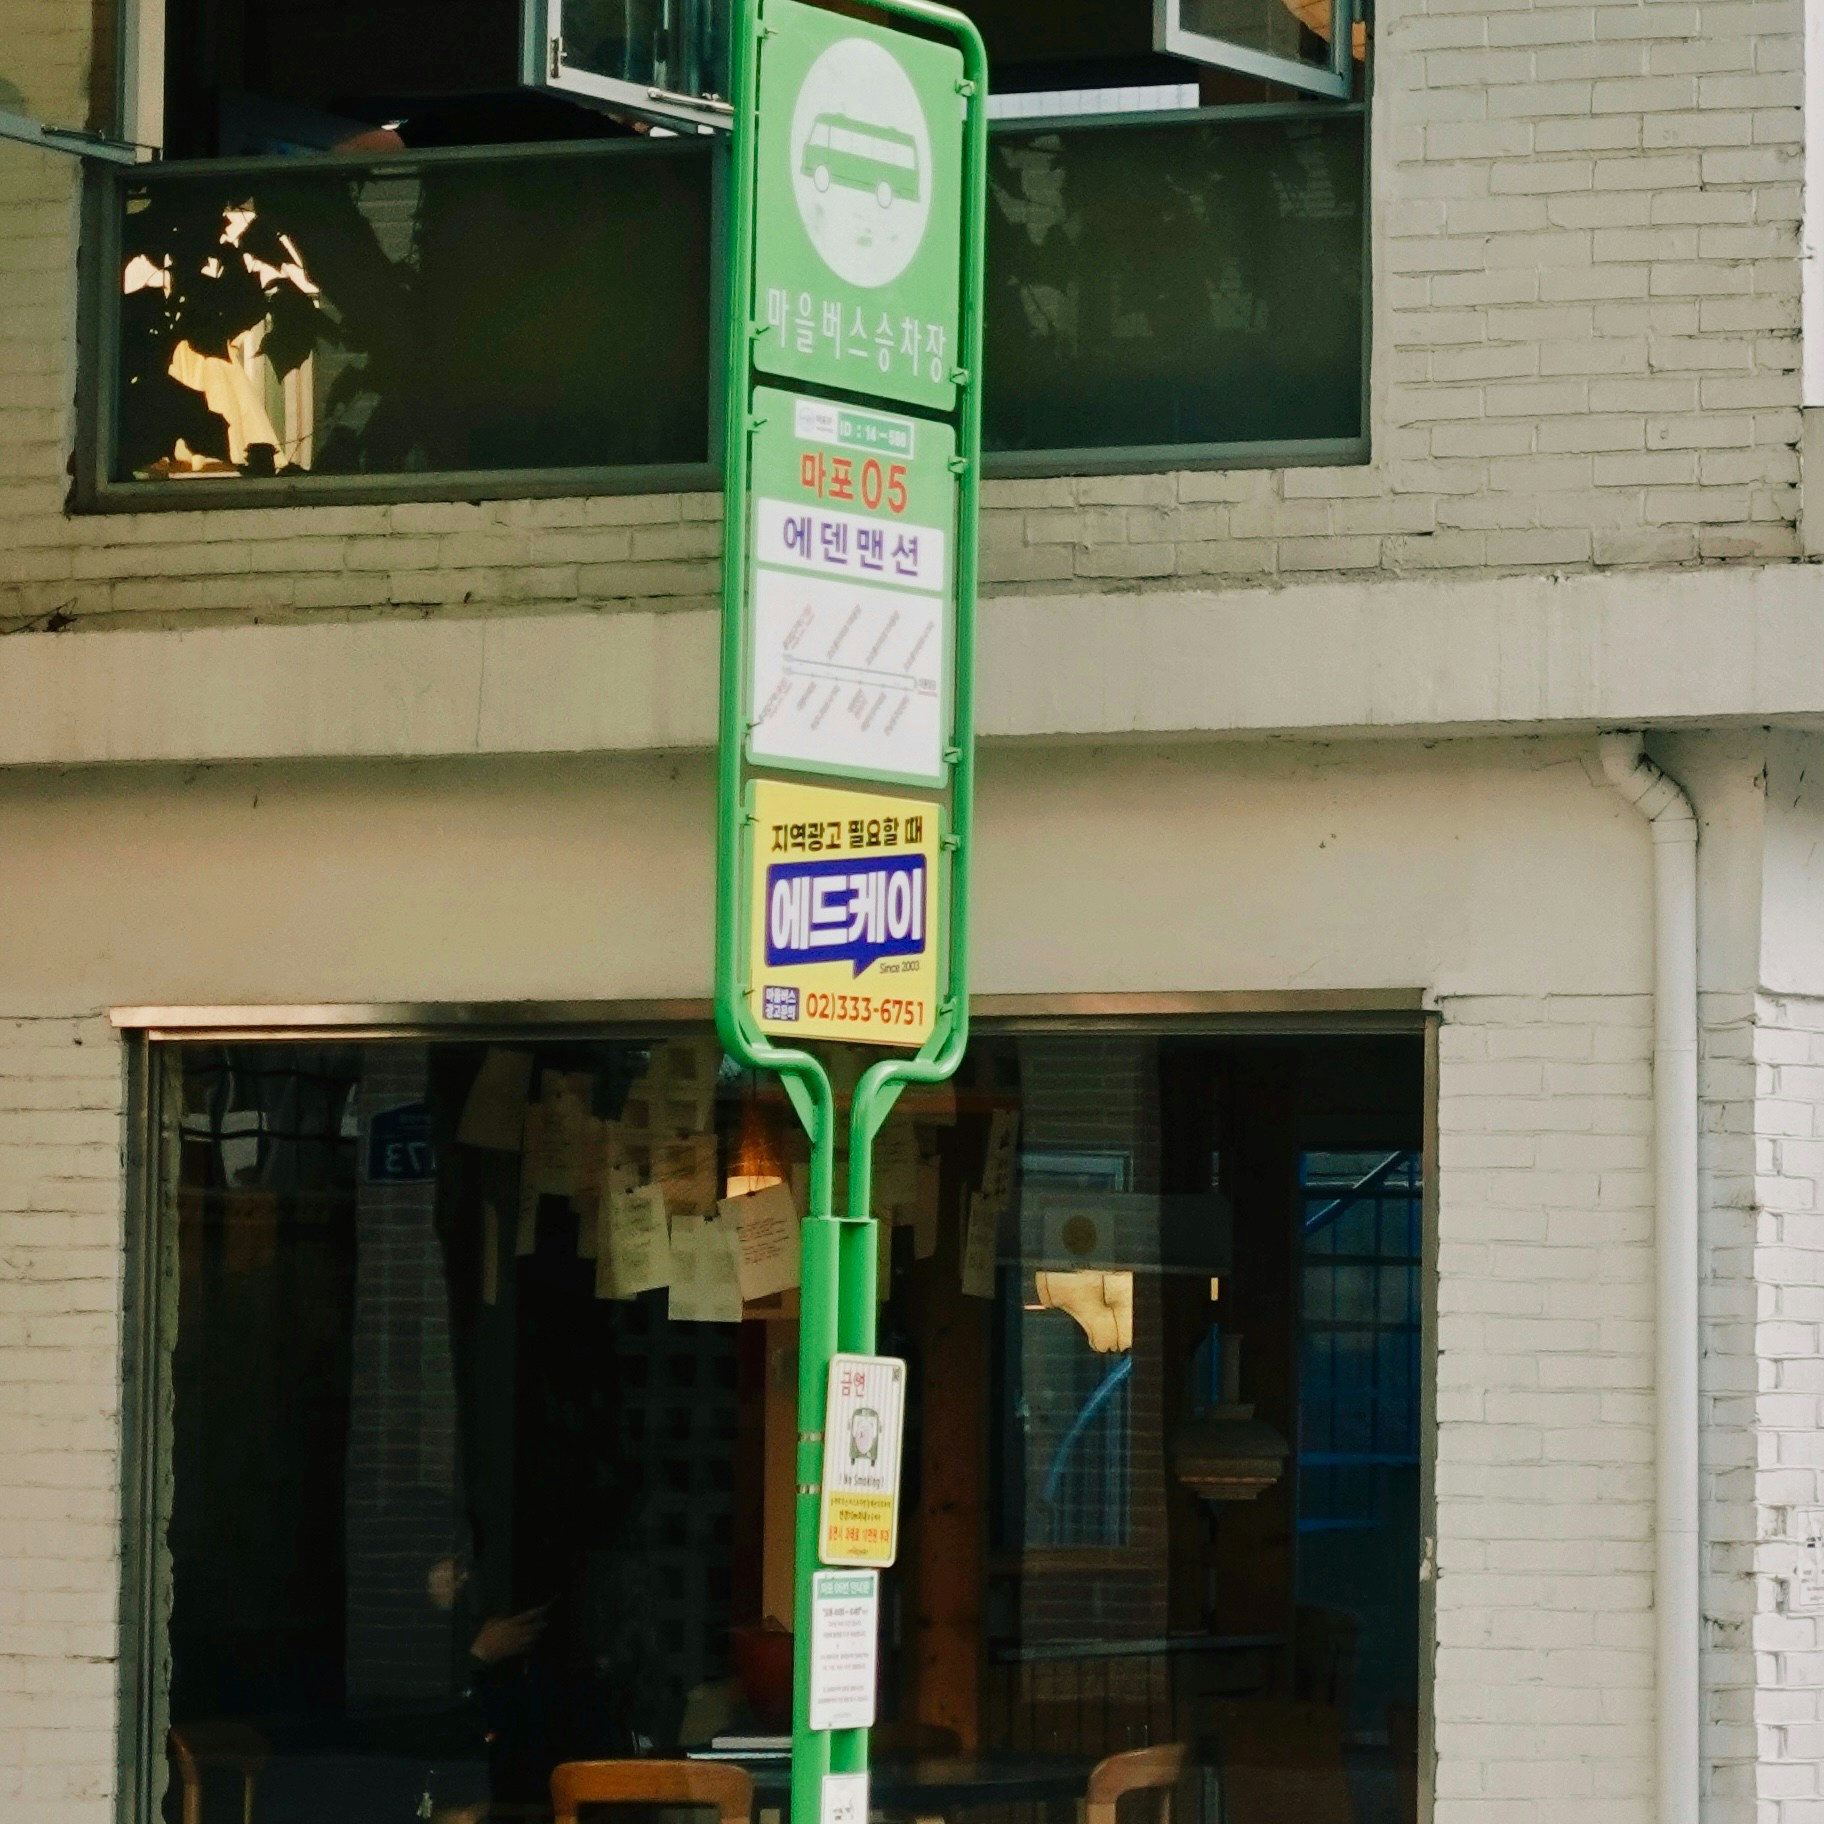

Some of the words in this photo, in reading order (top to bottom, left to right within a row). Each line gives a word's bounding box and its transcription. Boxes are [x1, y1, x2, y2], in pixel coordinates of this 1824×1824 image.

[768, 288, 946, 383] 마을버스승차장
[801, 451, 907, 513] 마포05
[783, 517, 918, 576] 에덴맨션
[771, 821, 841, 852] 지역광고
[848, 816, 900, 848] 필요할
[904, 815, 923, 844] 때
[770, 868, 922, 950] 에드케이
[879, 963, 900, 975] Since
[901, 961, 920, 973] 2003
[765, 987, 797, 1004] 마을버스
[806, 992, 924, 1026] 02)333-6751
[841, 1370, 866, 1397] 금연
